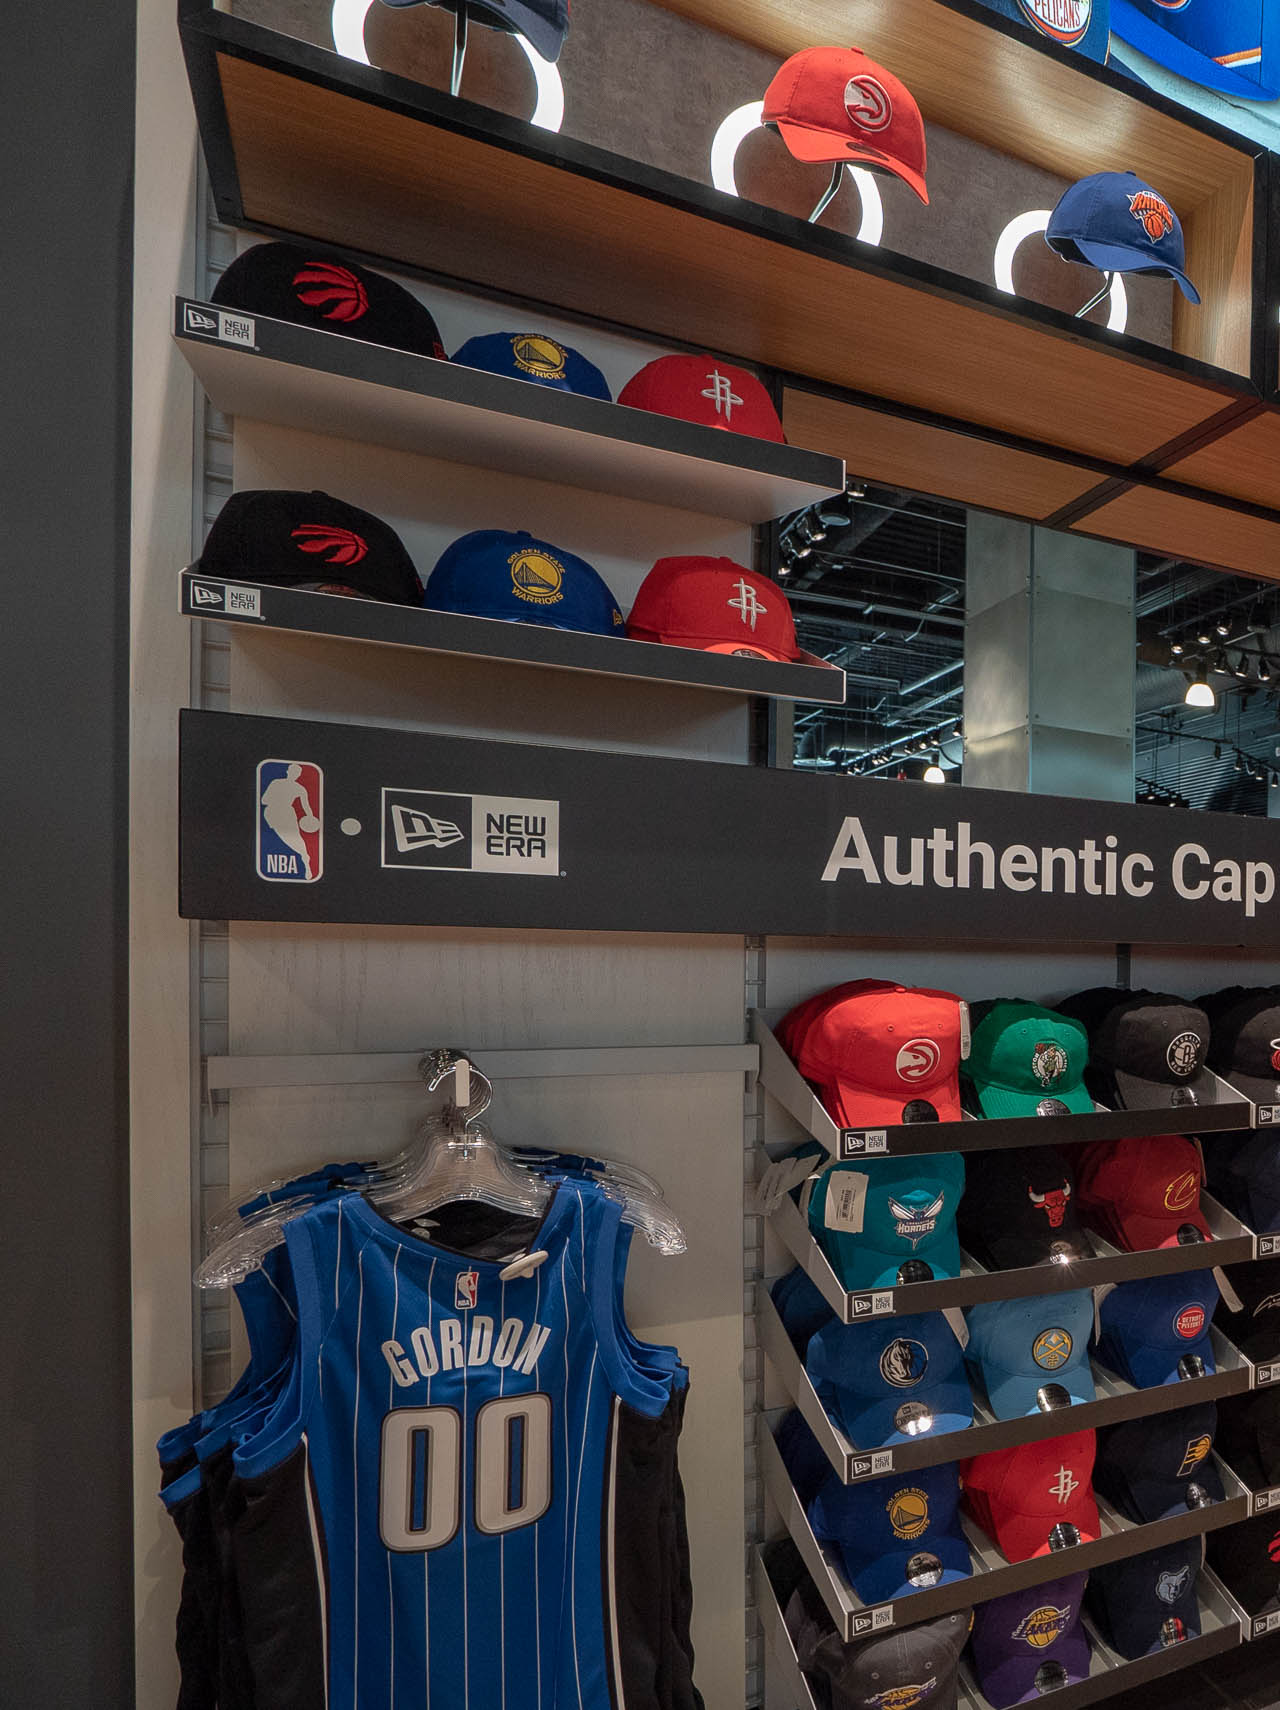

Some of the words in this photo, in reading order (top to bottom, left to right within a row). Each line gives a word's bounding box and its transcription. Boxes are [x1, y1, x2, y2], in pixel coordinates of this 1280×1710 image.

[1034, 0, 1081, 29] PELICANS
[224, 319, 250, 332] NEW
[224, 328, 250, 340] ERA
[230, 591, 256, 603] NEW
[511, 586, 565, 605] WARRIORS
[230, 600, 256, 611] ERA
[486, 812, 547, 837] NEW
[486, 834, 546, 859] ERA
[267, 854, 298, 874] NBA
[820, 816, 1154, 898] Authentic
[1171, 842, 1276, 918] Cap
[868, 1135, 884, 1143] NEW
[868, 1140, 884, 1148] ERA
[896, 1220, 936, 1234] HORNETS
[876, 1296, 891, 1304] NEW
[381, 1315, 552, 1388] GORDON
[874, 1455, 890, 1464] NEW
[378, 1392, 552, 1554] 00
[893, 1519, 931, 1540] WARRIORS
